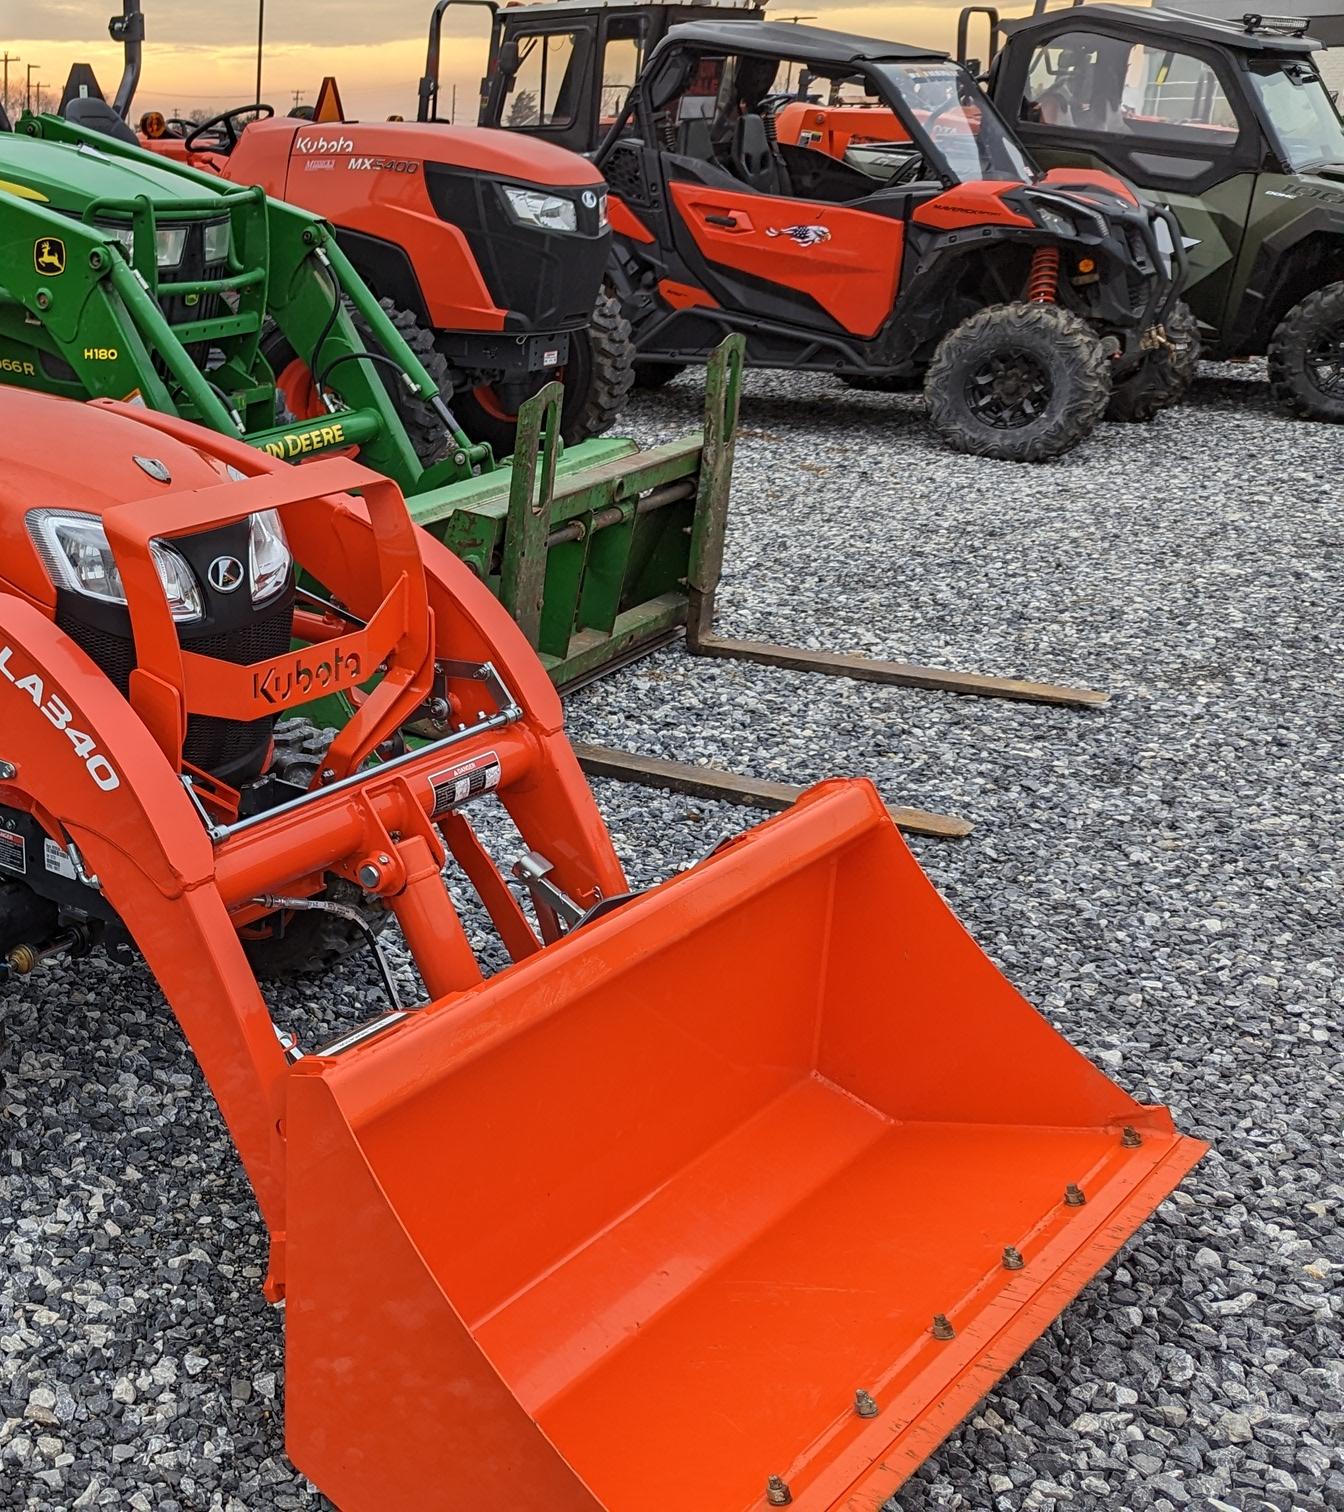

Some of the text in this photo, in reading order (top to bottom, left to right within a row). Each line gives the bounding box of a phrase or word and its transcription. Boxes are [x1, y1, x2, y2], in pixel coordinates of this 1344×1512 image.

[296, 136, 354, 153] Kubota
[347, 158, 419, 174] MX5400
[84, 347, 118, 360] H180
[284, 423, 345, 457] DEERE
[253, 647, 361, 703] Kubota
